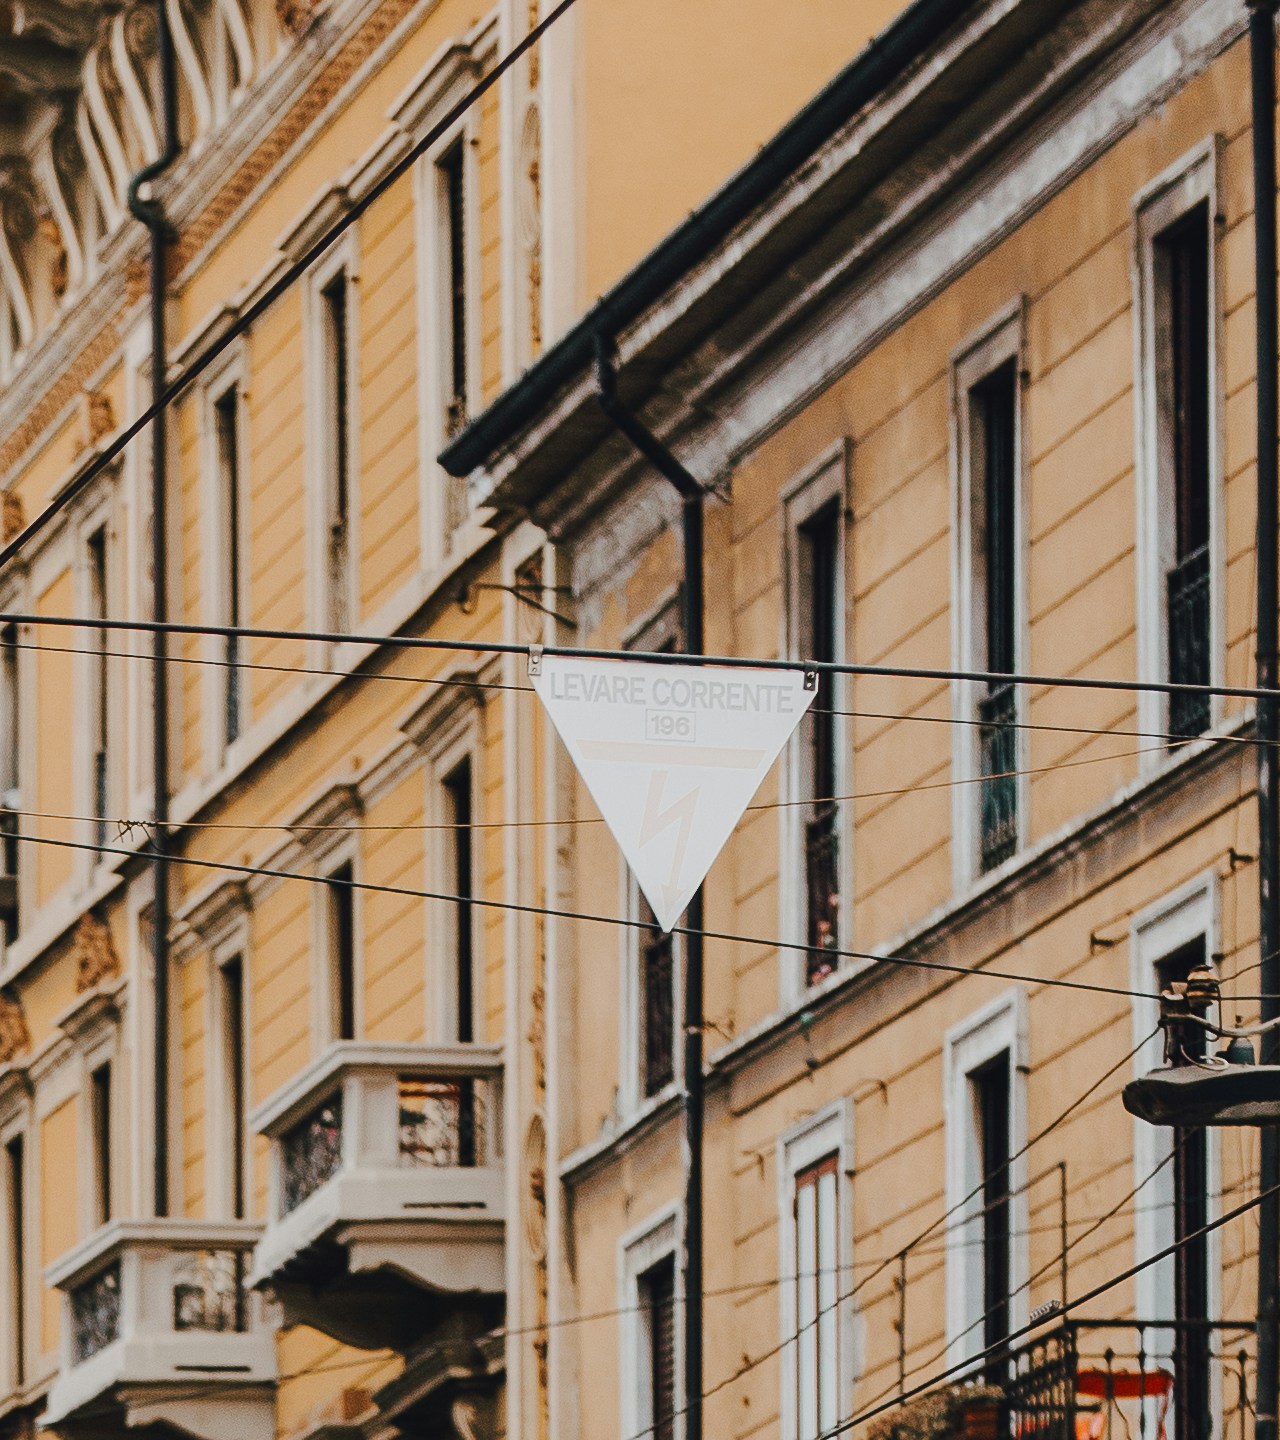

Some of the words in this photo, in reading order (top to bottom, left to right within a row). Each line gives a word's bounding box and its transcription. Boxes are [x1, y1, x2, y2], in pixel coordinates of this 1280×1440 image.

[550, 672, 646, 705] LEVARE
[652, 678, 793, 714] CORRENTE
[651, 714, 690, 736] 196
